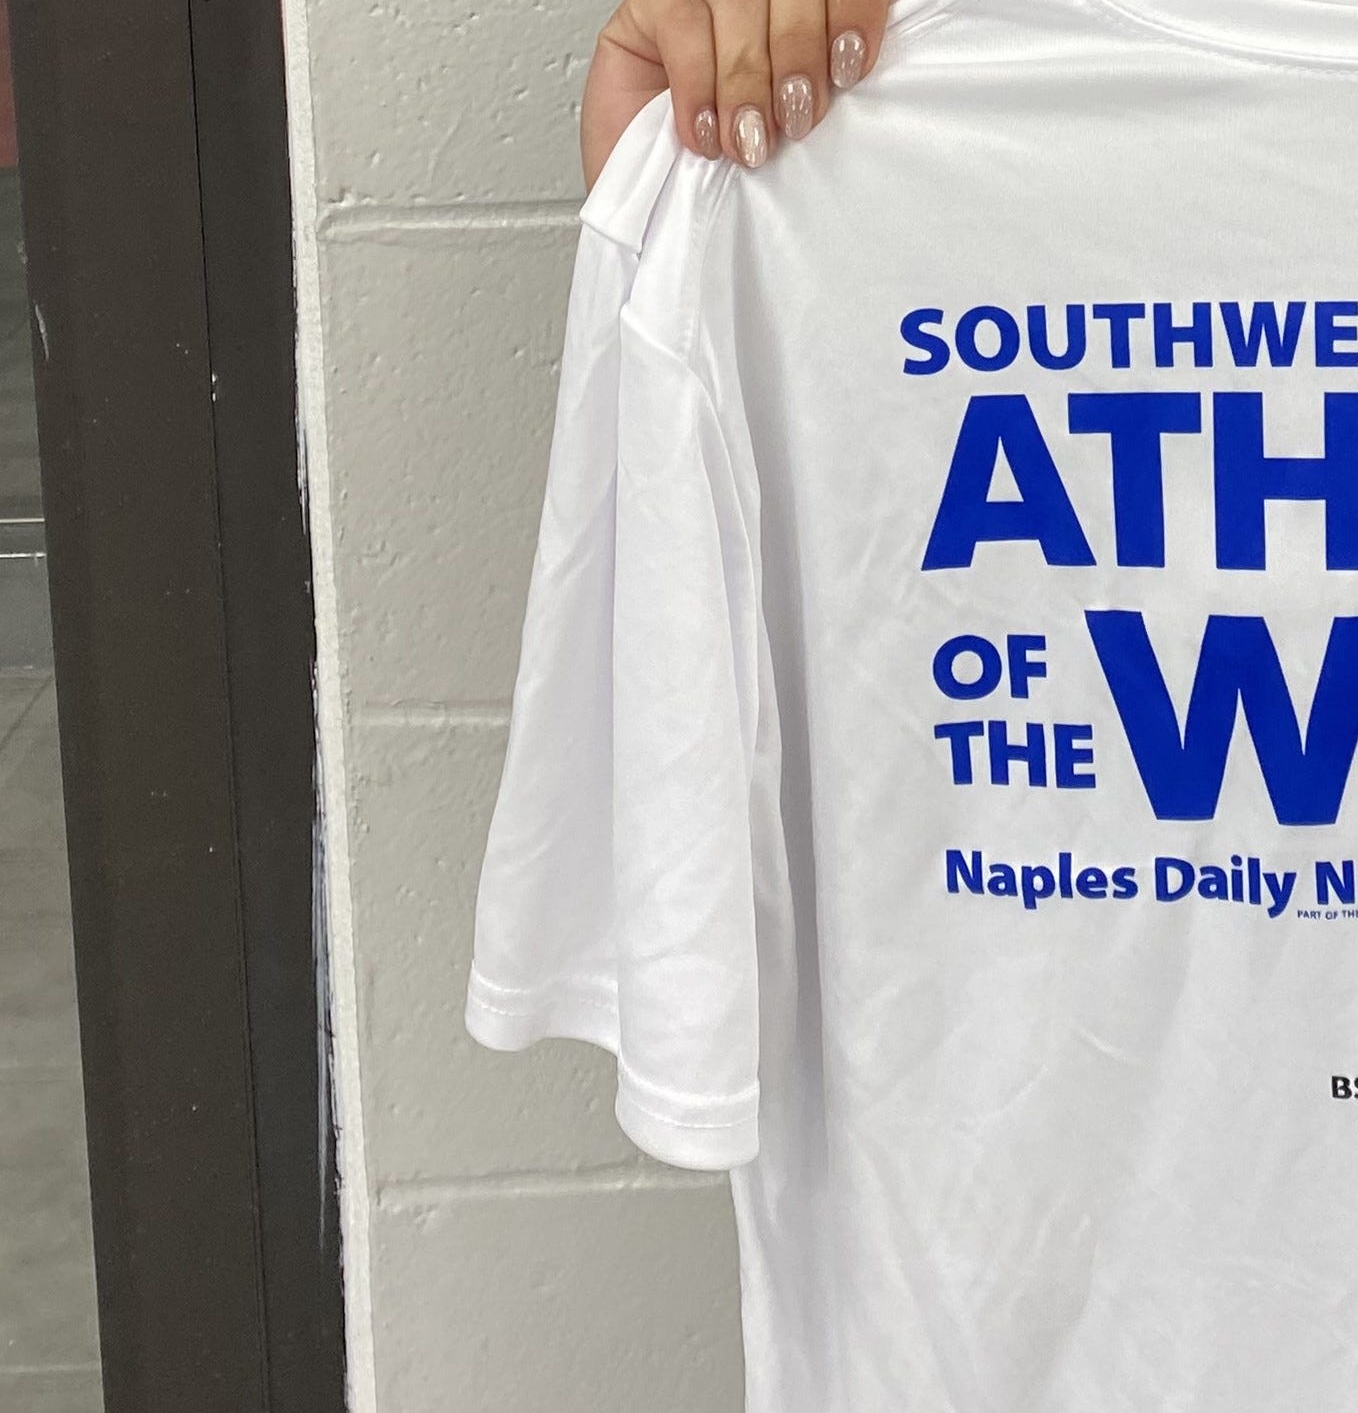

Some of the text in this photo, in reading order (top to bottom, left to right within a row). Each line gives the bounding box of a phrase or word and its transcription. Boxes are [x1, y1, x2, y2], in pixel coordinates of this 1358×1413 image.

[932, 634, 1047, 700] OF
[934, 719, 1096, 789] THE
[945, 849, 1138, 910] Naples
[1154, 855, 1296, 918] Daily
[1297, 909, 1321, 919] PART
[1325, 910, 1338, 920] OF
